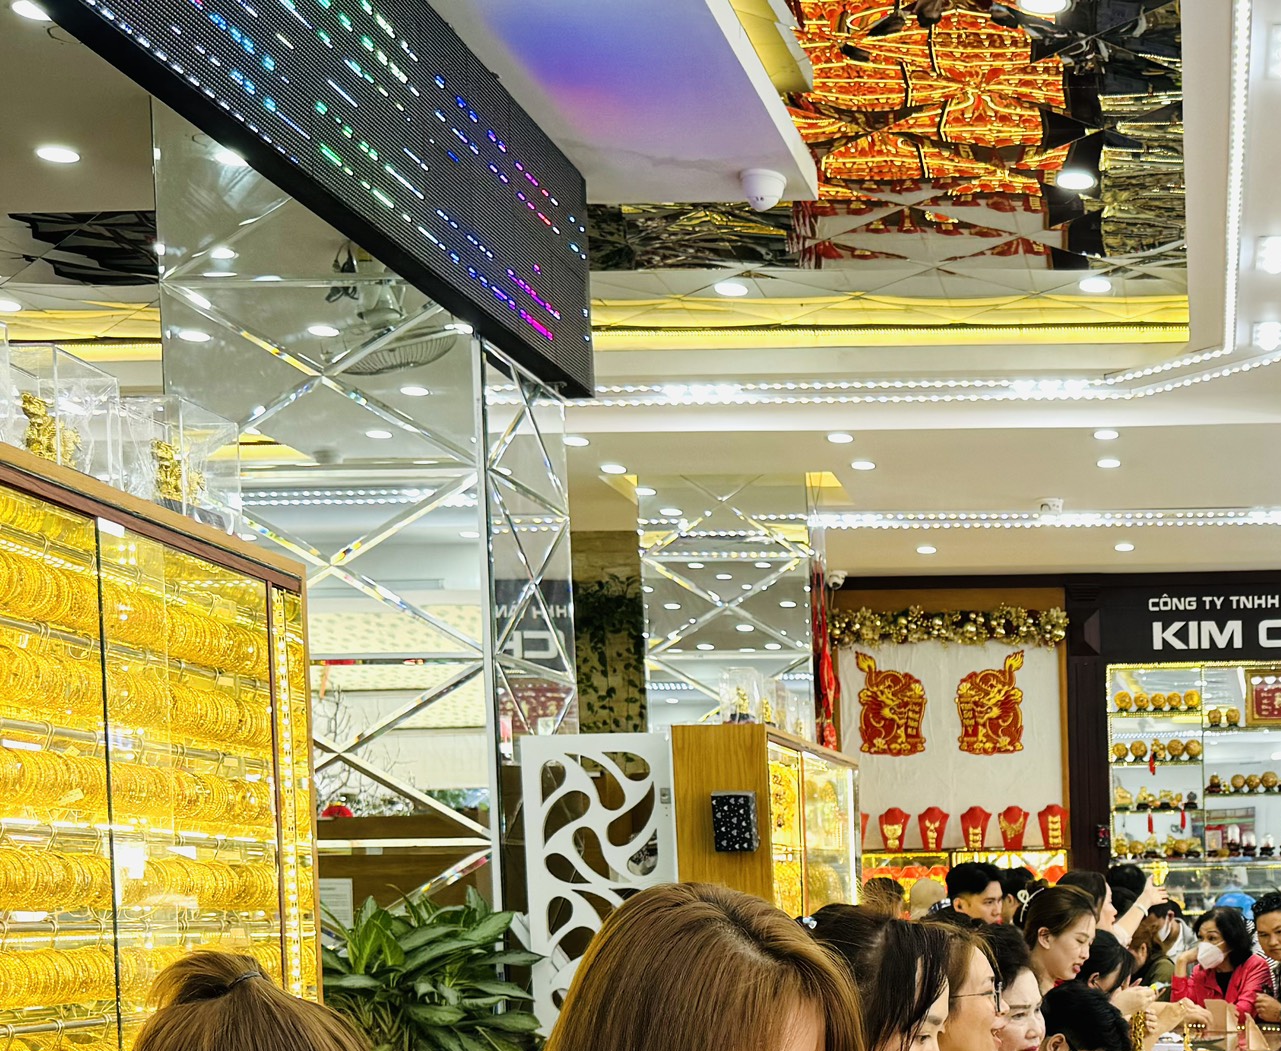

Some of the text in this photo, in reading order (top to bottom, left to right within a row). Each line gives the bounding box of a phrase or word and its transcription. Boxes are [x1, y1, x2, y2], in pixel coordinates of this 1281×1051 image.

[1148, 593, 1197, 611] CÔNG
[1202, 596, 1224, 610] TY
[1229, 595, 1280, 610] TNHH
[1152, 620, 1243, 650] KIM
